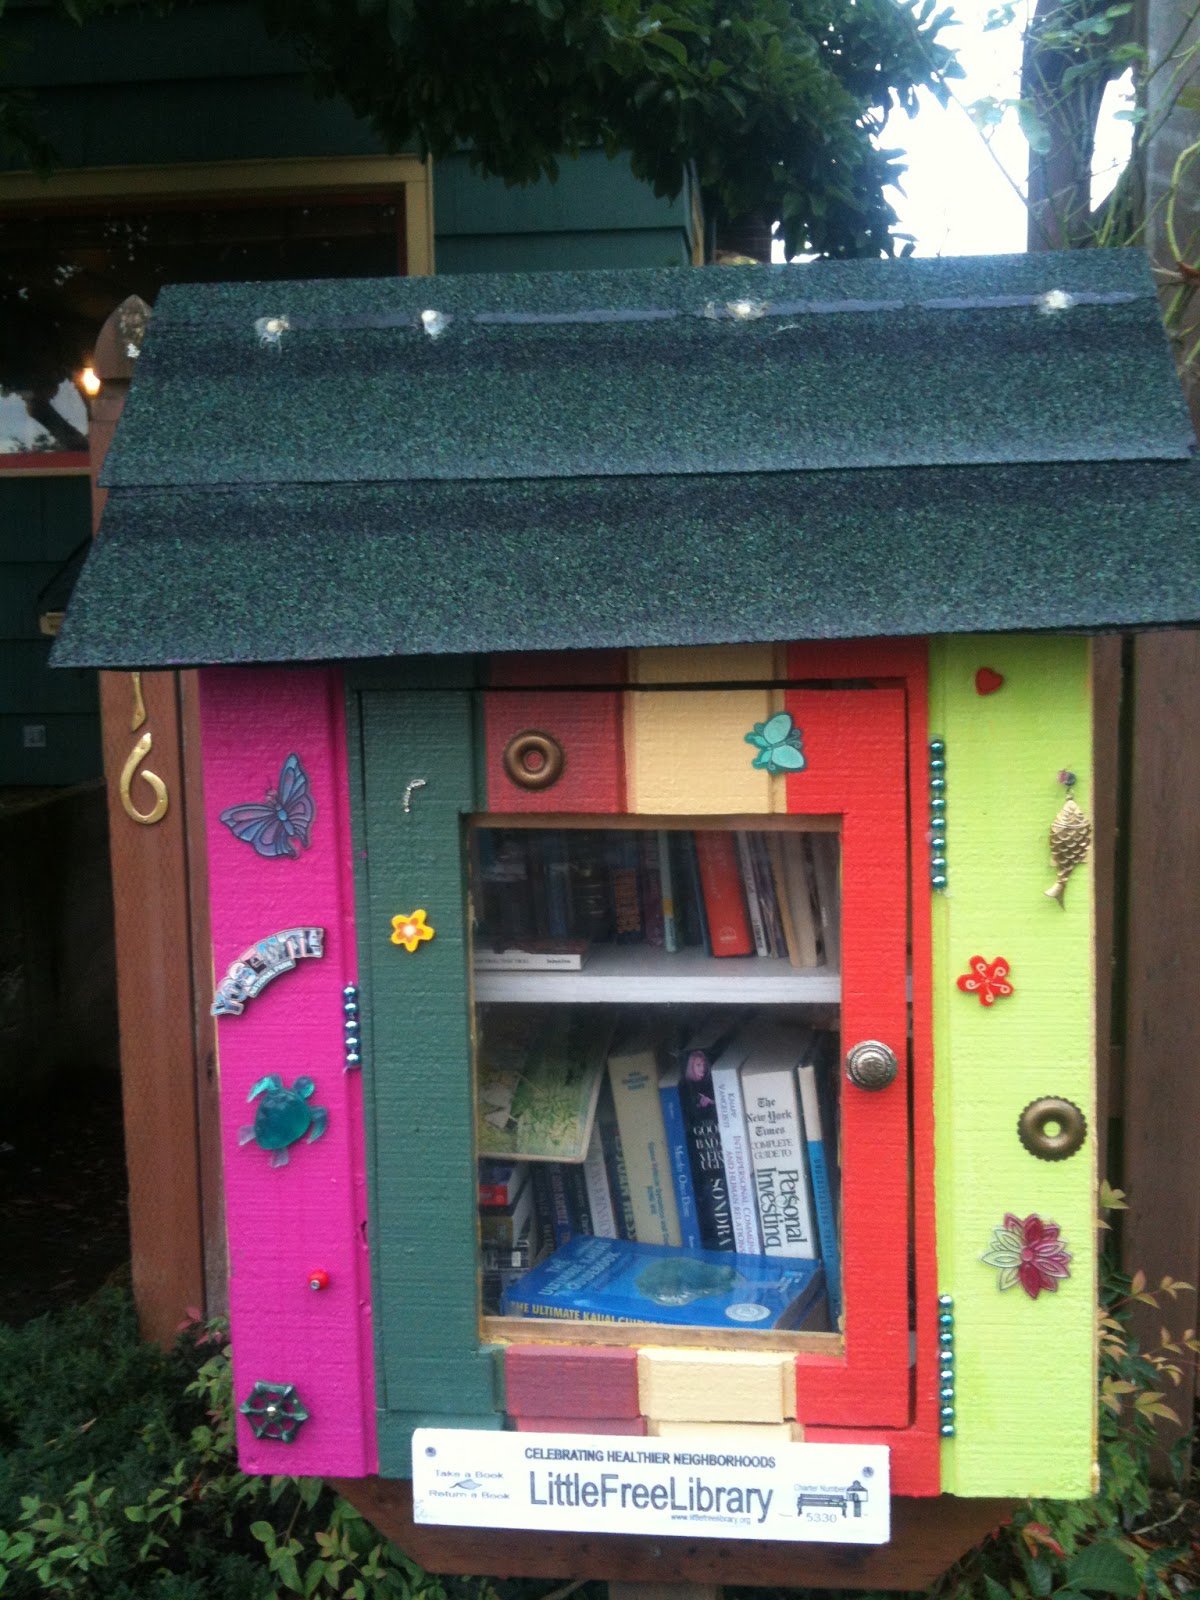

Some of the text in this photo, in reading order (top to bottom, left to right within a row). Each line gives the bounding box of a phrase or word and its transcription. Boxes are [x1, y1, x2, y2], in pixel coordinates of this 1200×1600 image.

[120, 732, 168, 825] 6
[212, 927, 324, 1015] YOSEMITE
[757, 1097, 776, 1108] The
[746, 1109, 792, 1124] New York
[755, 1126, 785, 1137] Times
[752, 1138, 793, 1150] COMPLETE
[754, 1149, 792, 1160] GUIDE TO
[711, 1178, 733, 1246] SONDRA
[757, 1167, 782, 1248] Investing
[778, 1169, 808, 1243] Personal
[532, 1304, 580, 1320] ULTIMATE
[525, 1447, 776, 1469] CELEBRATING HEALTHIER NEIGHBORHOODS
[436, 1469, 460, 1478] Take
[475, 1471, 504, 1479] Book
[428, 1489, 467, 1498] Return
[481, 1492, 510, 1500] Book
[806, 1512, 837, 1523] 5330
